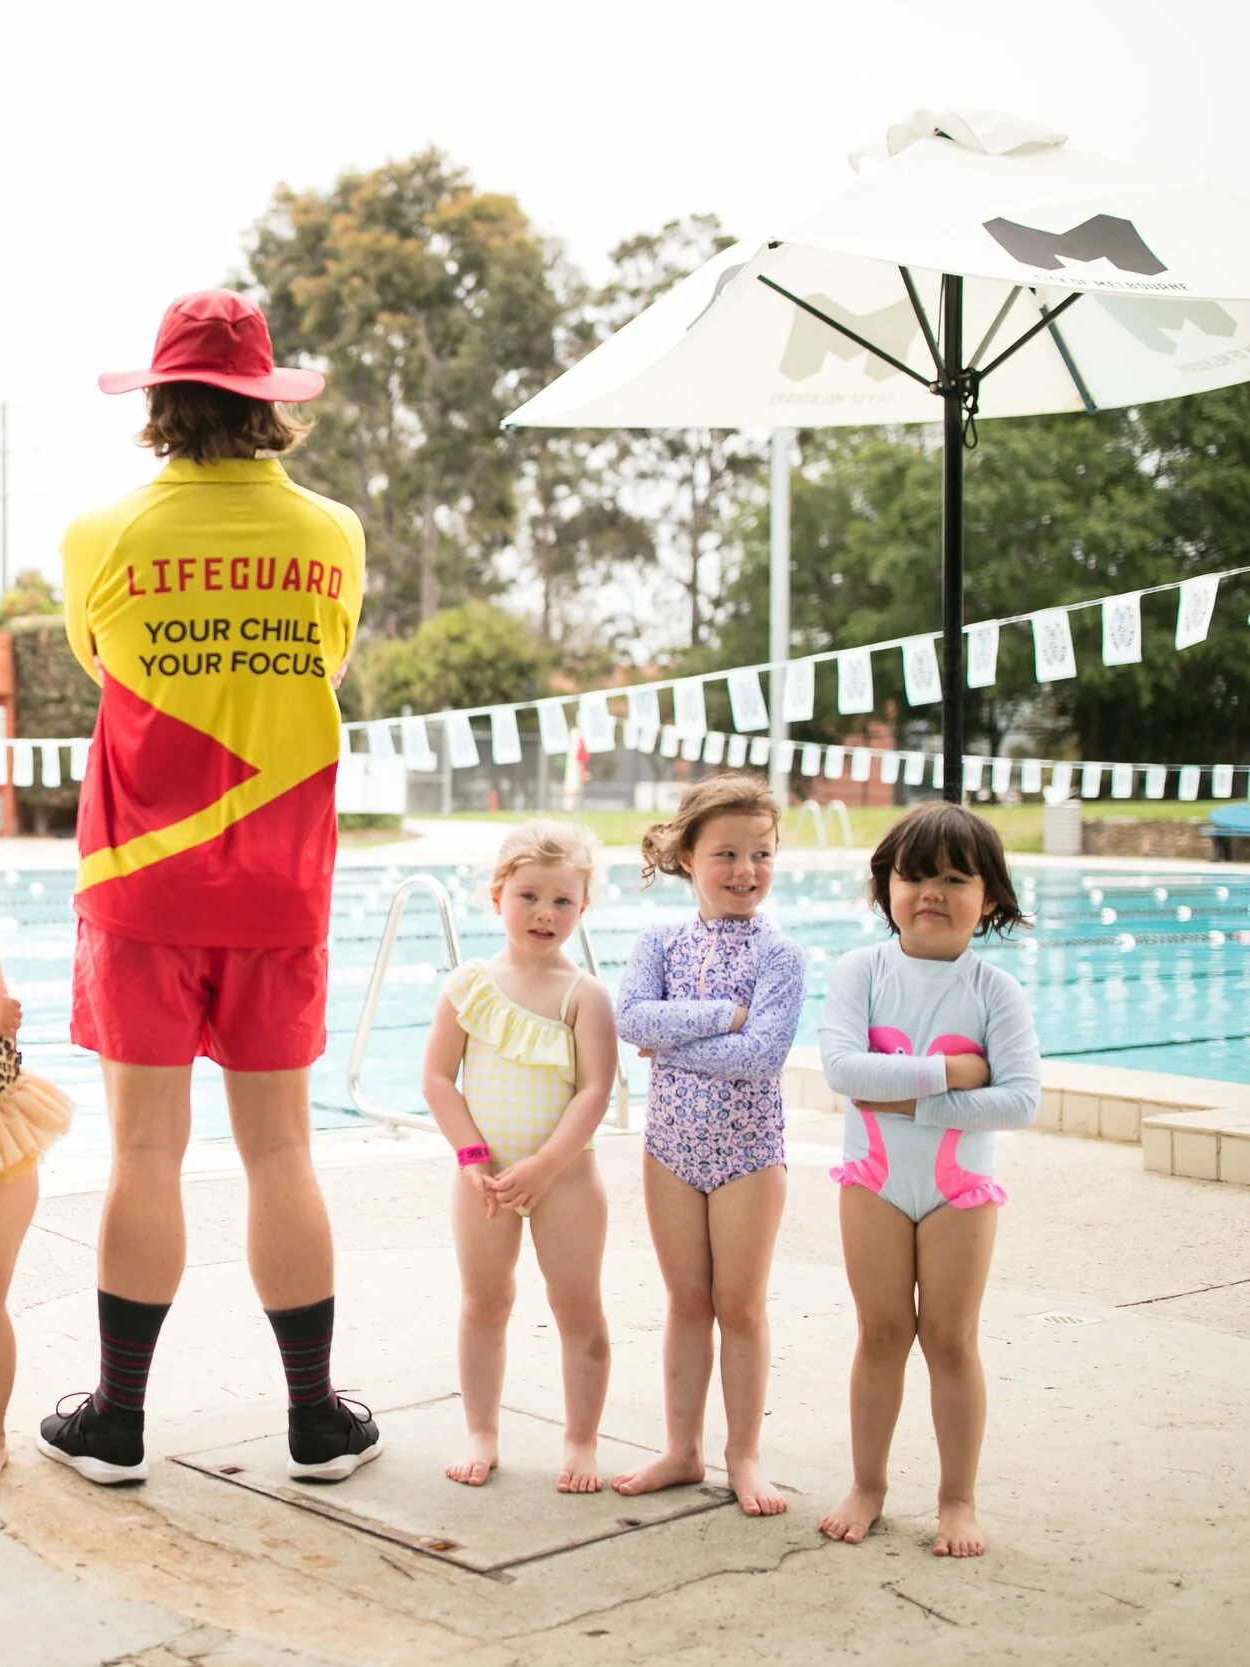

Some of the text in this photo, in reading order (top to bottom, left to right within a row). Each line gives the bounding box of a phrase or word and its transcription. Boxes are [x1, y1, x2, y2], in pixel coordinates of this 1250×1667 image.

[1093, 279, 1192, 292] MELBOURNE
[127, 557, 343, 600] LIFEGUARD
[144, 618, 321, 645] YOUR CHILD
[139, 651, 325, 679] YOUR FOCUS
